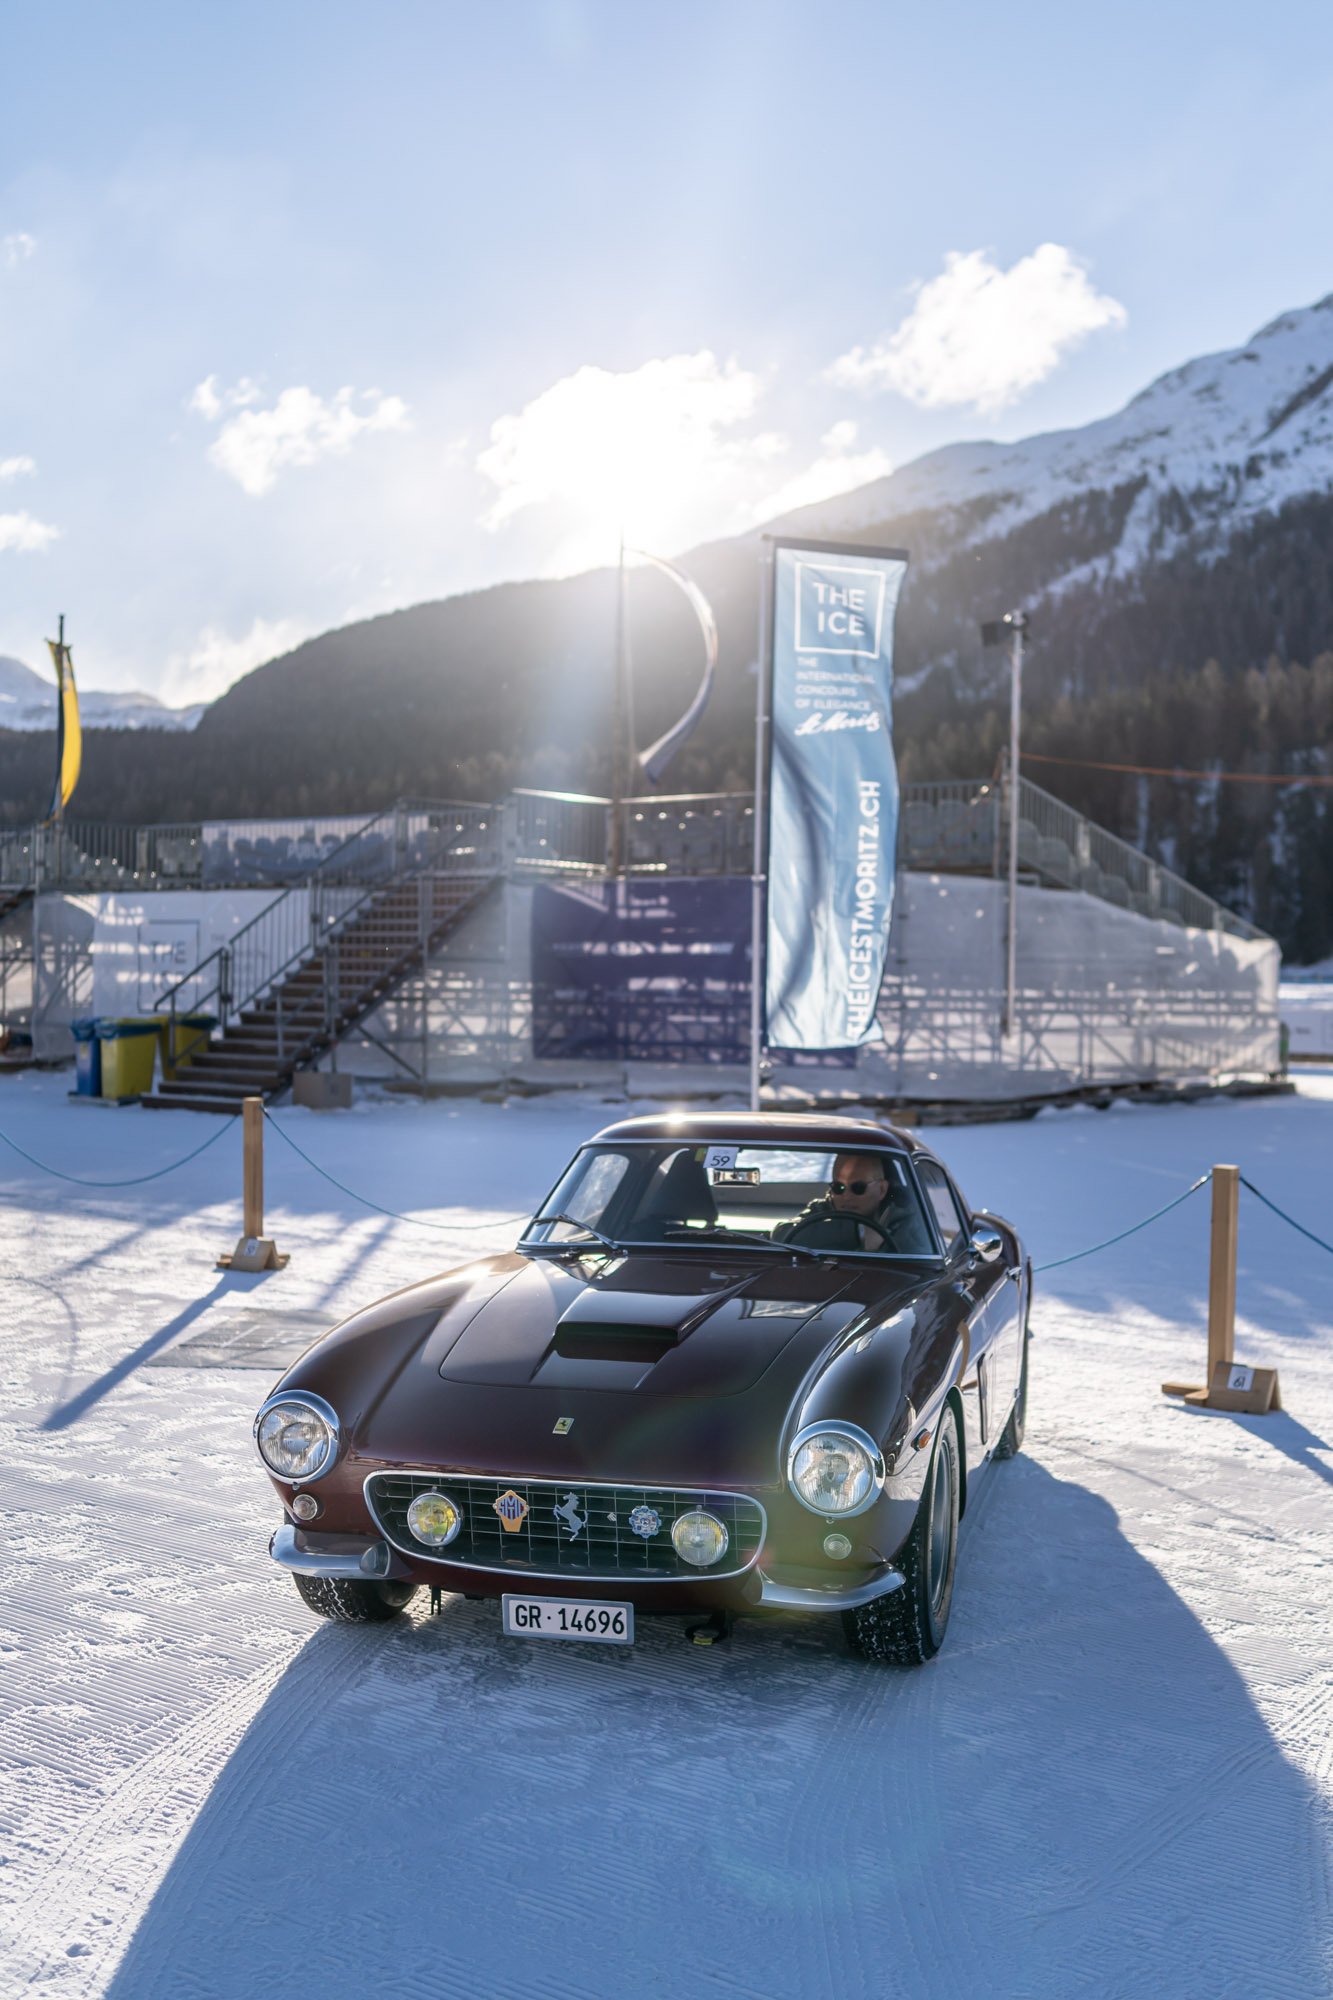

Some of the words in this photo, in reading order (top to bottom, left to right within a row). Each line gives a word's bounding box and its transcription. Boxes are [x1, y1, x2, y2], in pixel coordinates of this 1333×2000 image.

[813, 582, 866, 611] THE
[817, 611, 865, 636] ICE
[710, 1155, 731, 1167] 59
